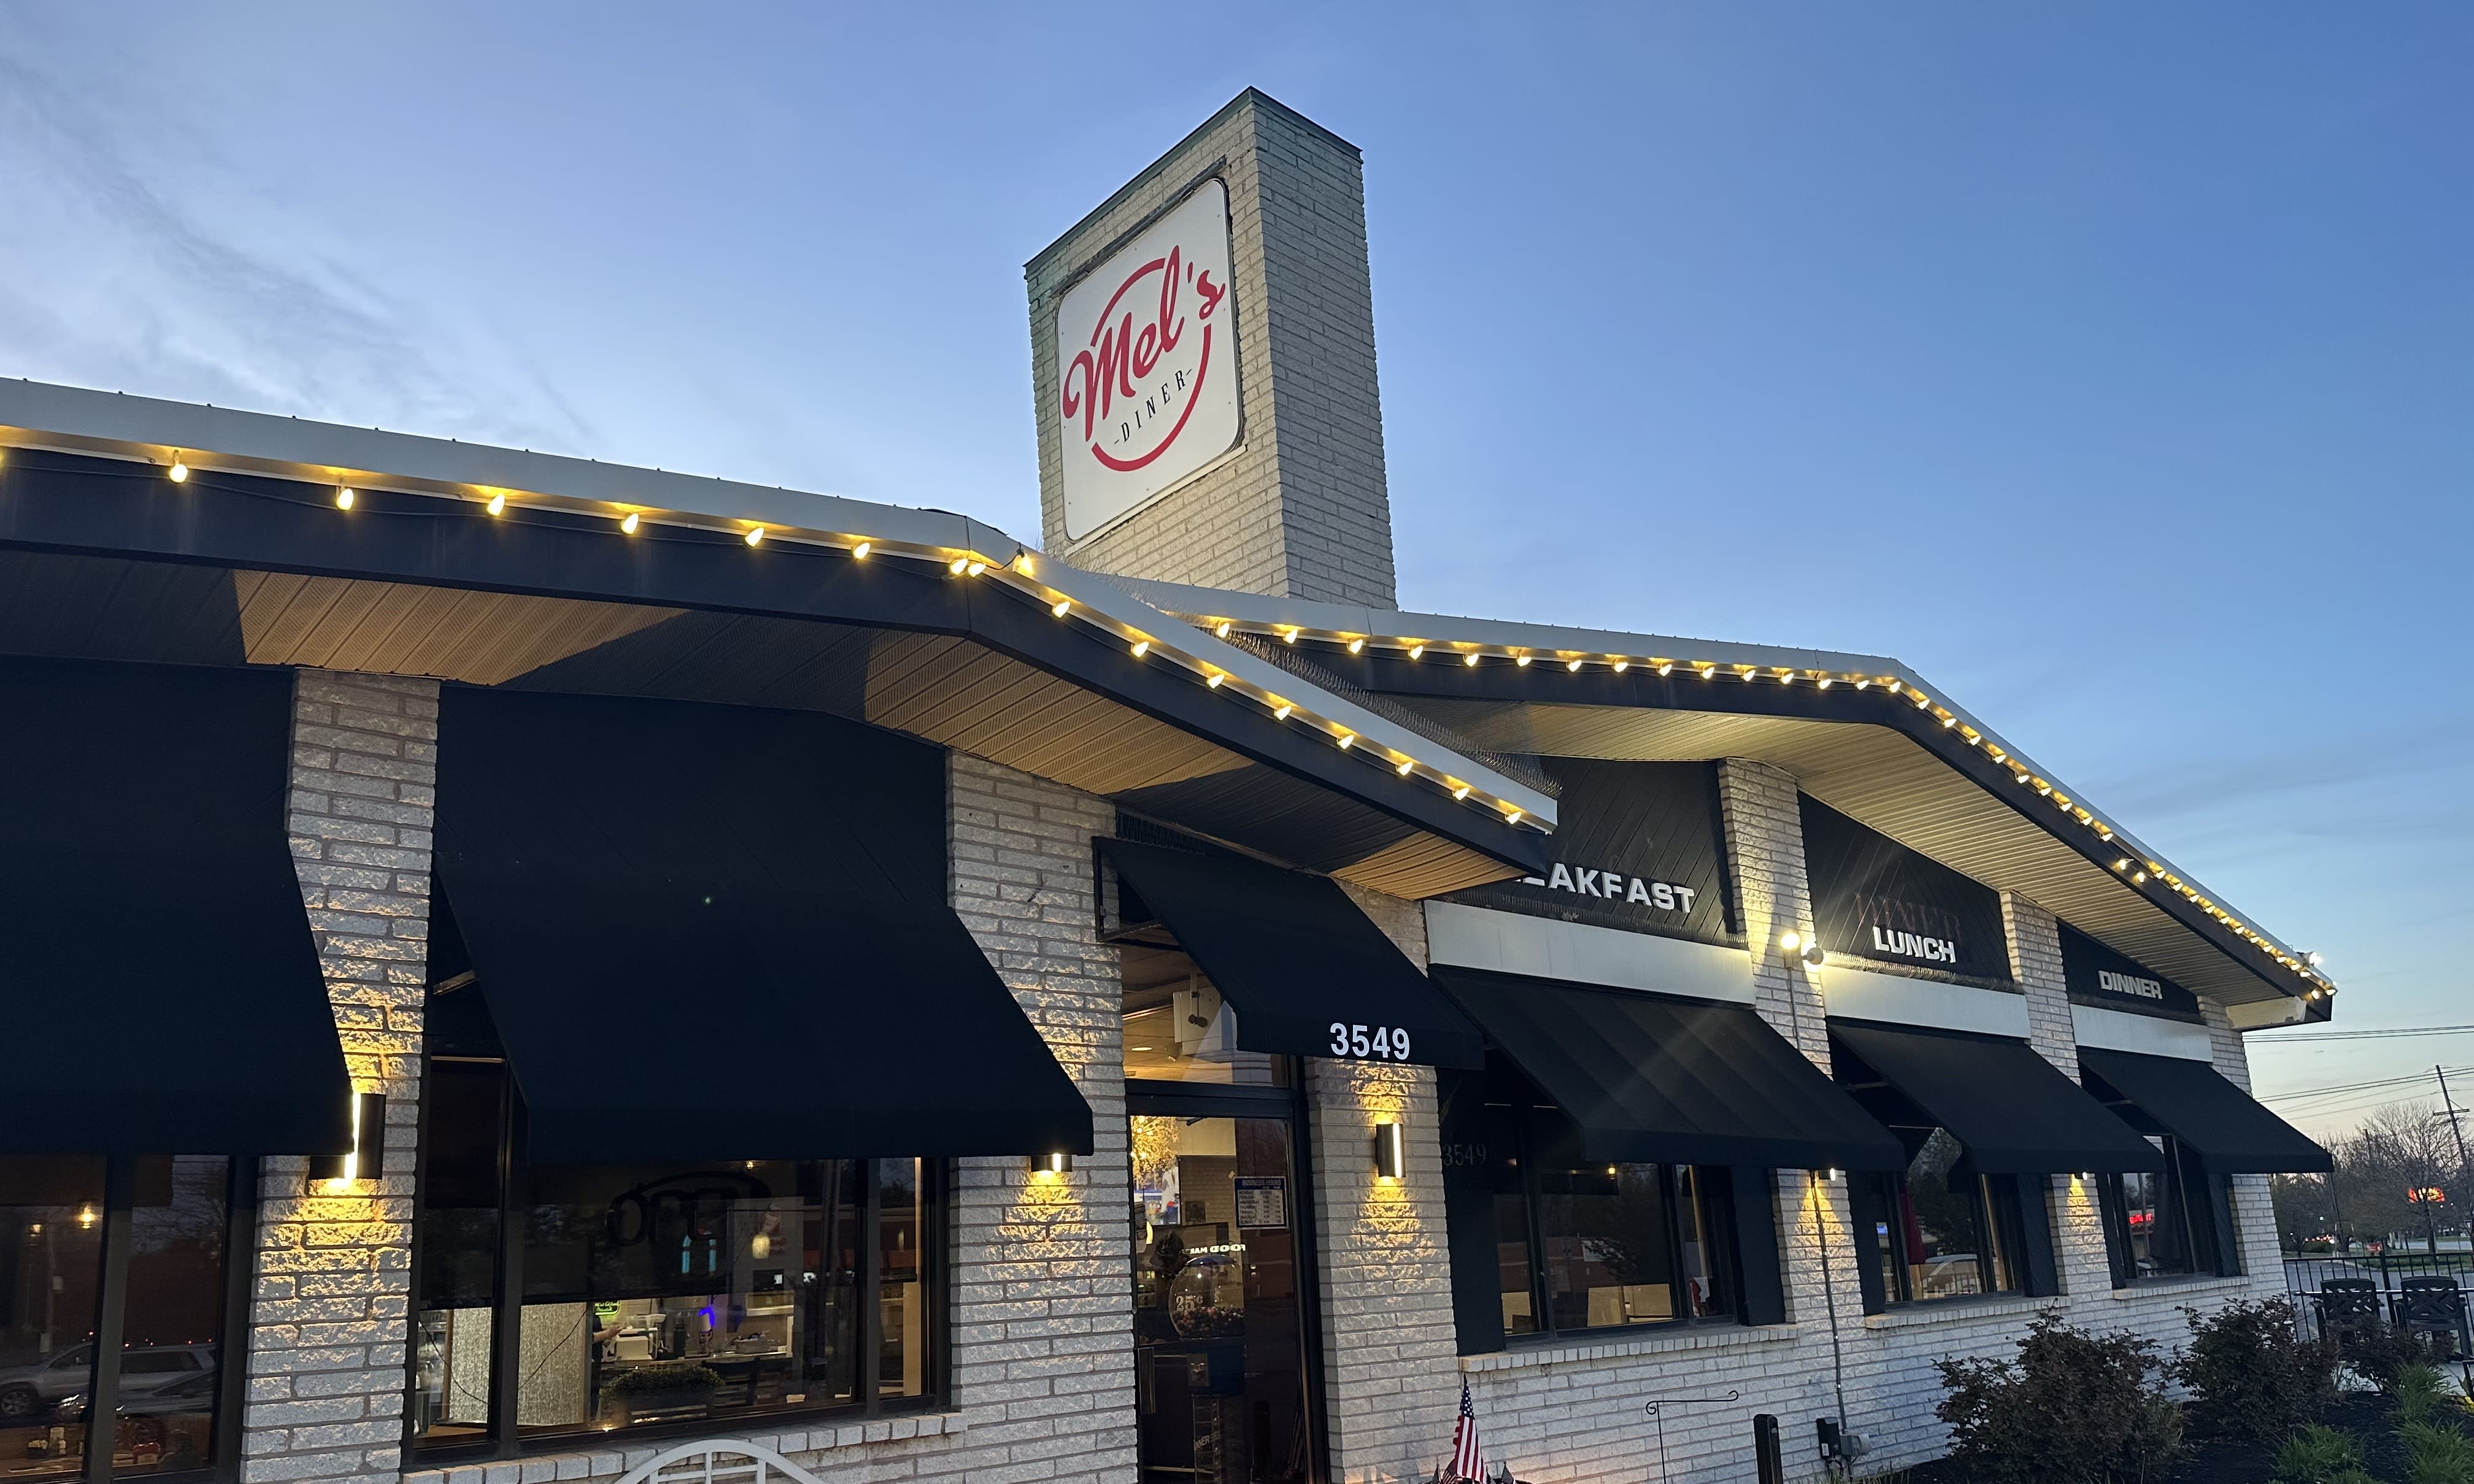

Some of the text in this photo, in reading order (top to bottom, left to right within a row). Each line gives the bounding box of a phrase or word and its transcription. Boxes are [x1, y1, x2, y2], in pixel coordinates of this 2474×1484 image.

[1063, 245, 1225, 442] Mel's
[1514, 863, 1694, 913] AKFAST
[1873, 926, 1956, 963] LUNCH
[2098, 971, 2162, 999] DINNER
[1330, 1023, 1410, 1059] 3549
[1443, 1144, 1487, 1166] 3549
